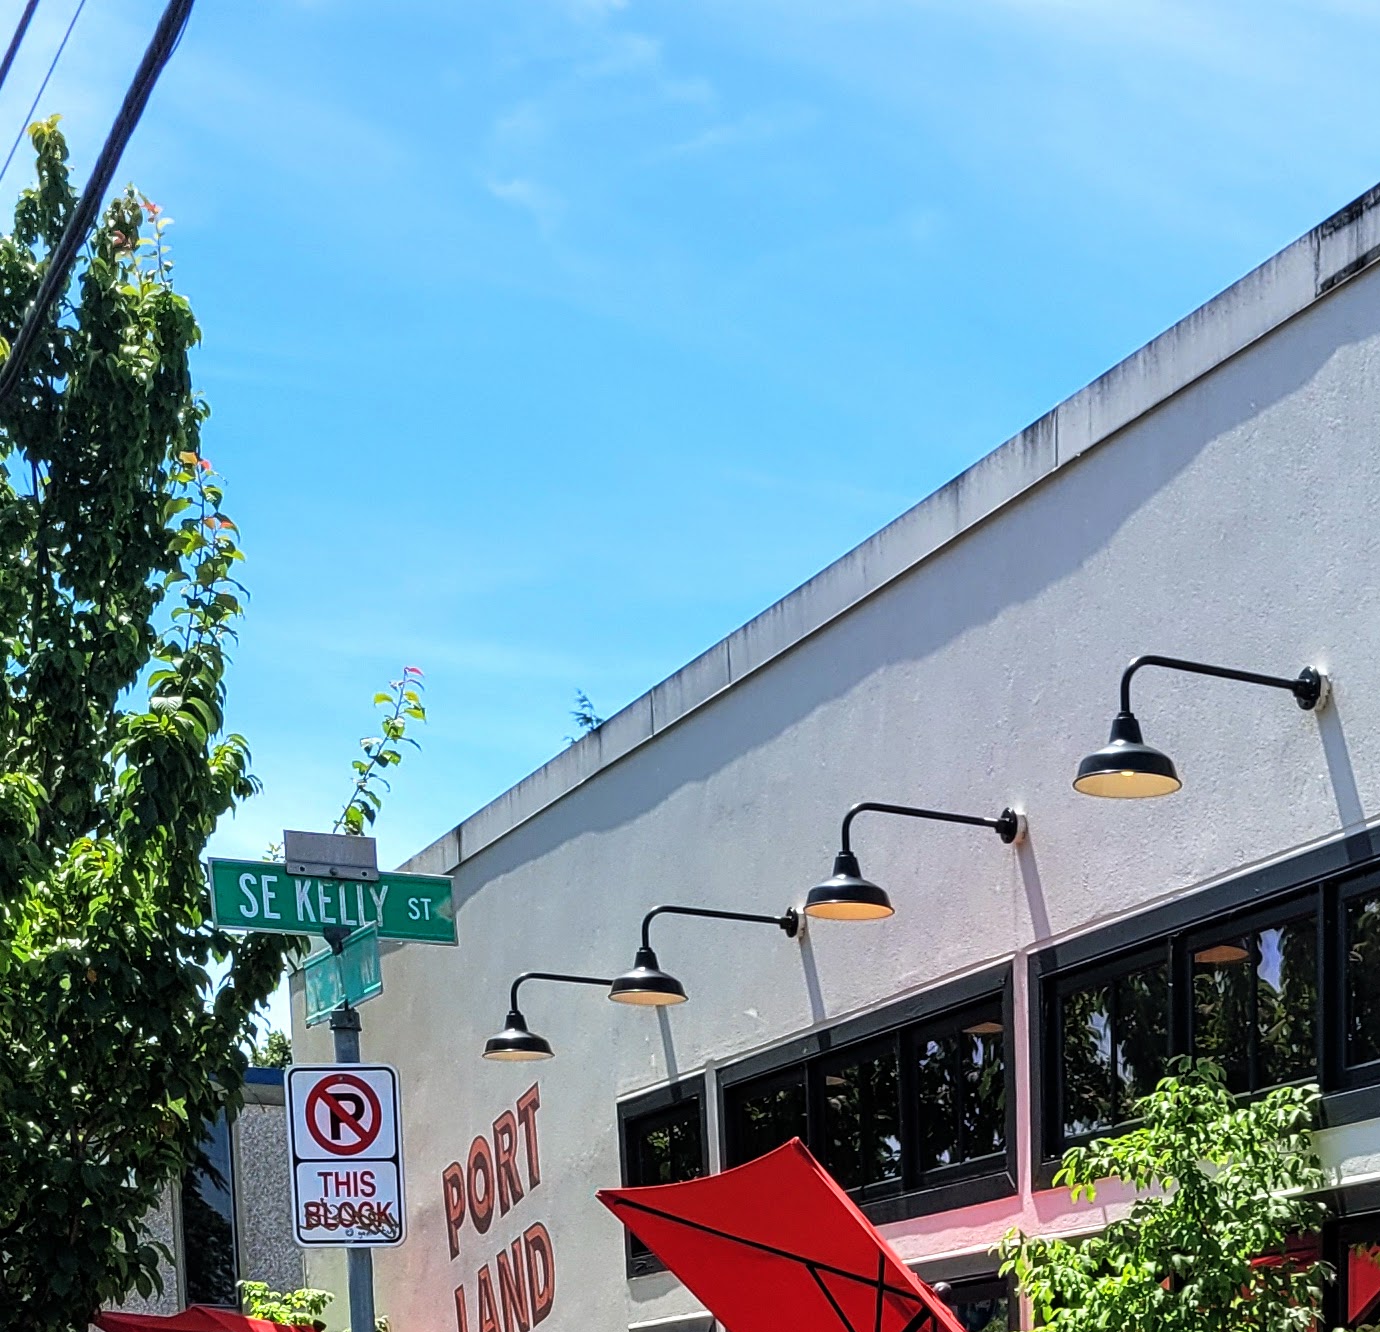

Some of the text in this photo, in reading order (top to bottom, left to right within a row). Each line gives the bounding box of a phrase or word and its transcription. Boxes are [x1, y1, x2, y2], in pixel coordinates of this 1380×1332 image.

[238, 872, 432, 928] SE KELLY ST
[317, 1171, 376, 1198] THIS
[442, 1081, 541, 1261] PORT
[304, 1201, 394, 1228] BLOCK
